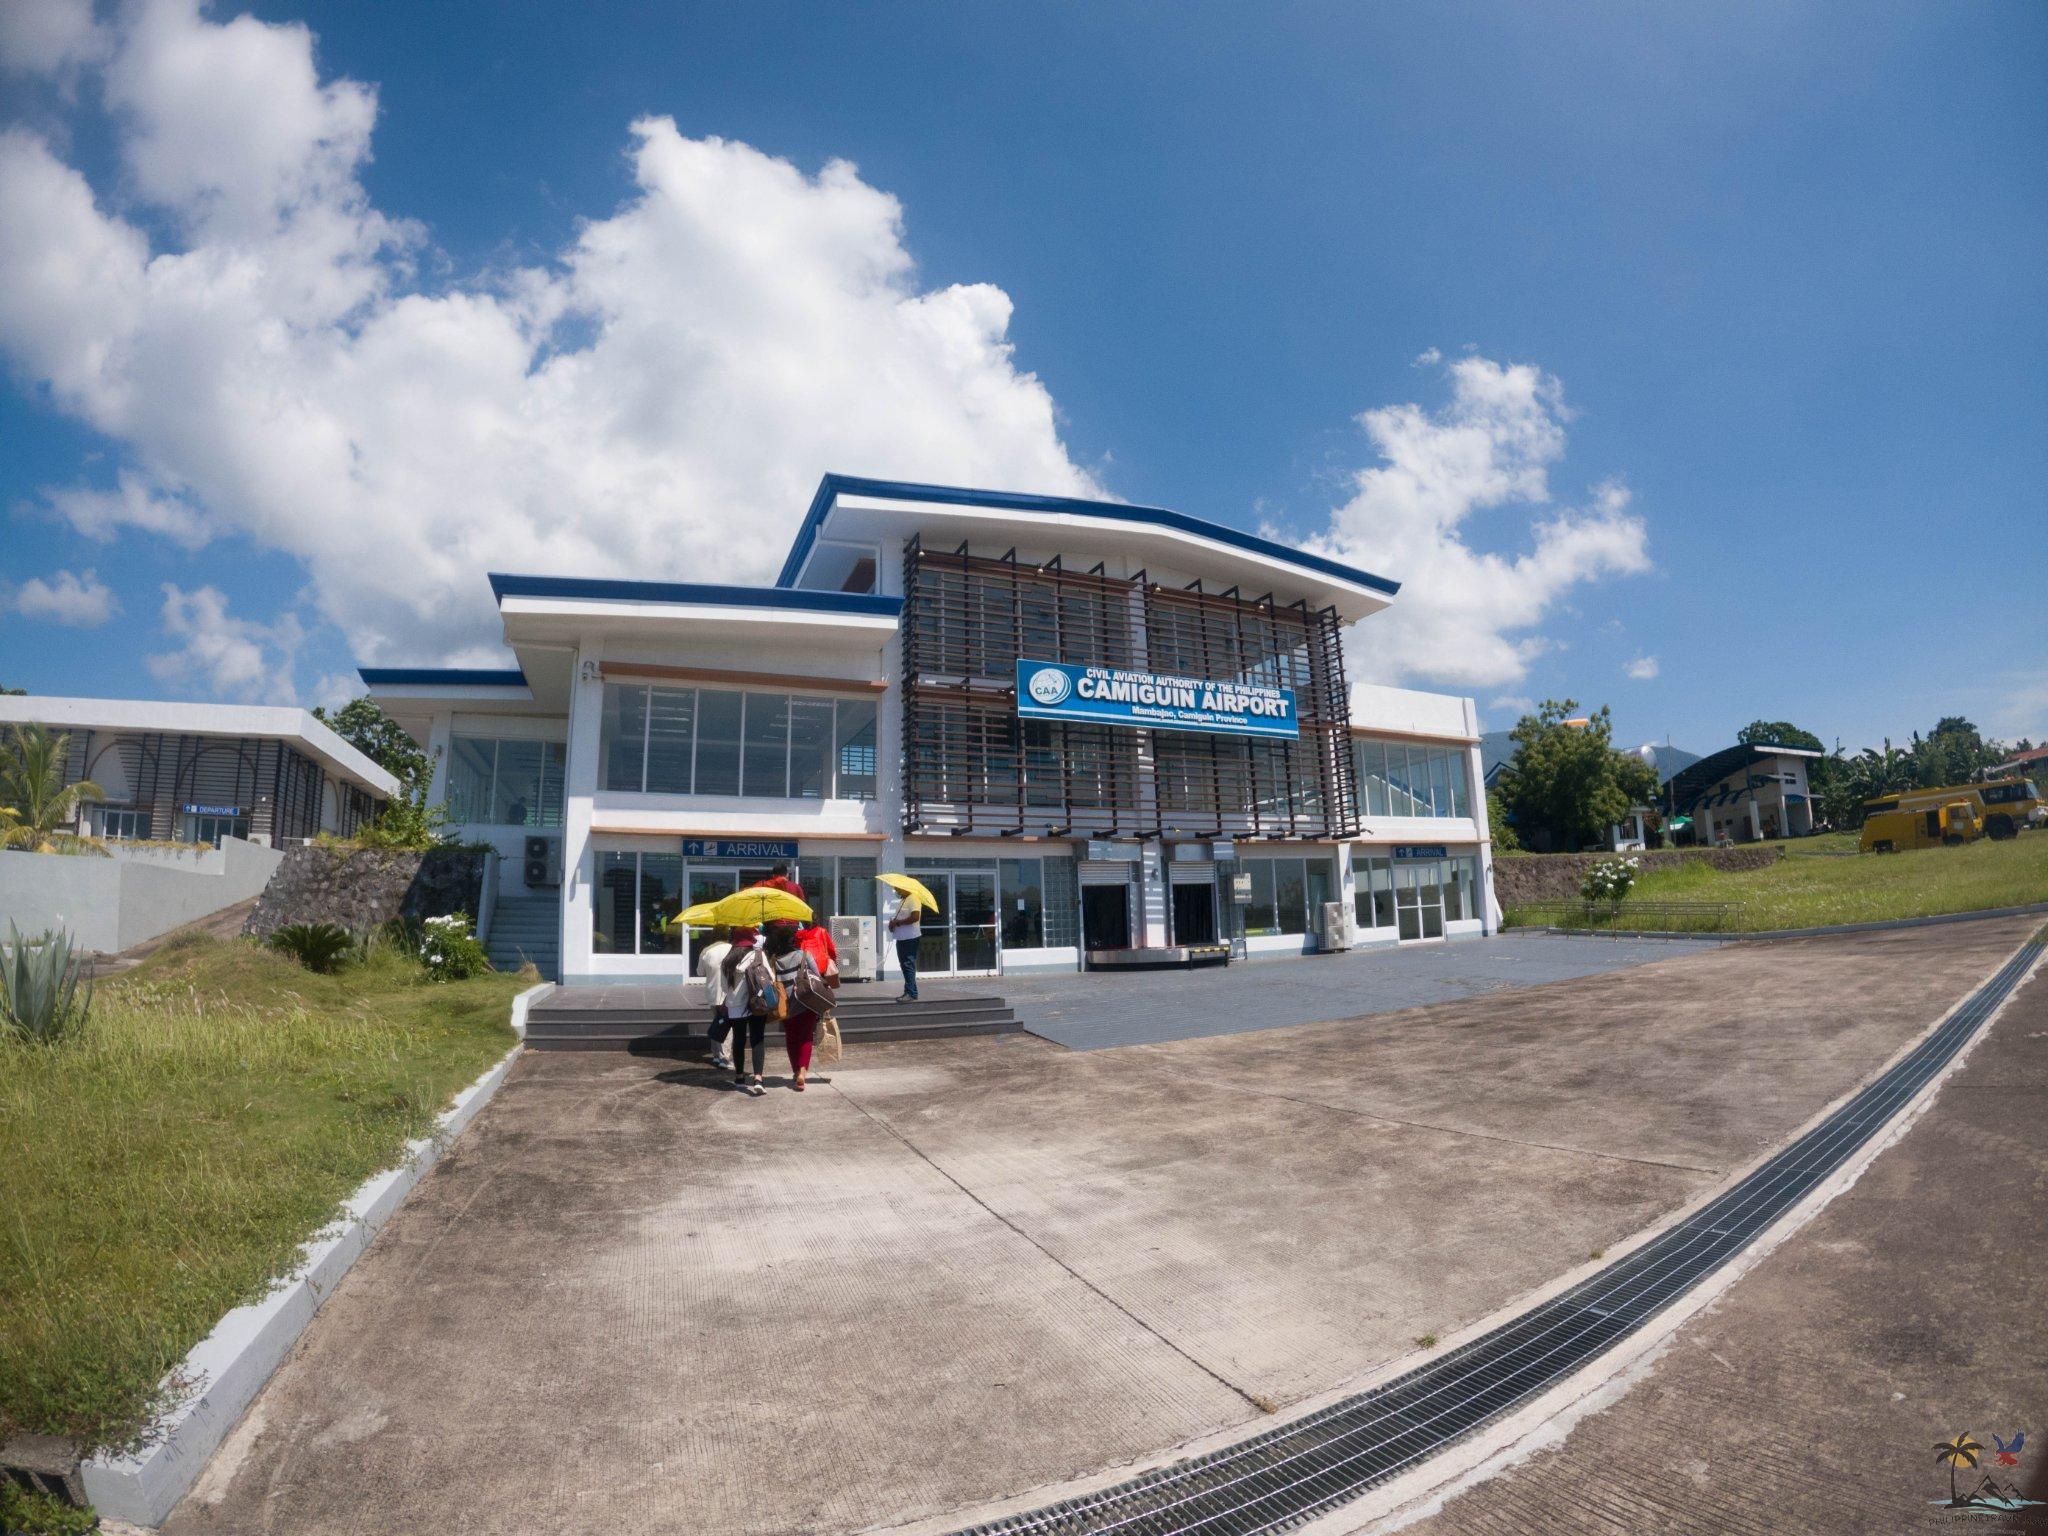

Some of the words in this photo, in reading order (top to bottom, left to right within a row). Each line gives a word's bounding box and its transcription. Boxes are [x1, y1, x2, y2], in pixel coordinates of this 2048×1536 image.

[1035, 686, 1059, 695] CAA
[1087, 668, 1111, 680] CIVIL
[1113, 671, 1154, 685] AVIATION
[1156, 677, 1203, 690] AUTHORITY
[1205, 682, 1216, 692] OF
[1217, 683, 1234, 694] THE
[1235, 686, 1281, 699] PHILIPPINES
[1077, 677, 1196, 709] CAMIGUIN
[1202, 691, 1289, 717] AIRPORT
[1132, 706, 1177, 720] Mambajao,
[1178, 710, 1215, 724] Camiguin
[1215, 714, 1248, 725] Province
[727, 843, 788, 857] ARRIVAL
[1416, 847, 1444, 857] ARRIVAL
